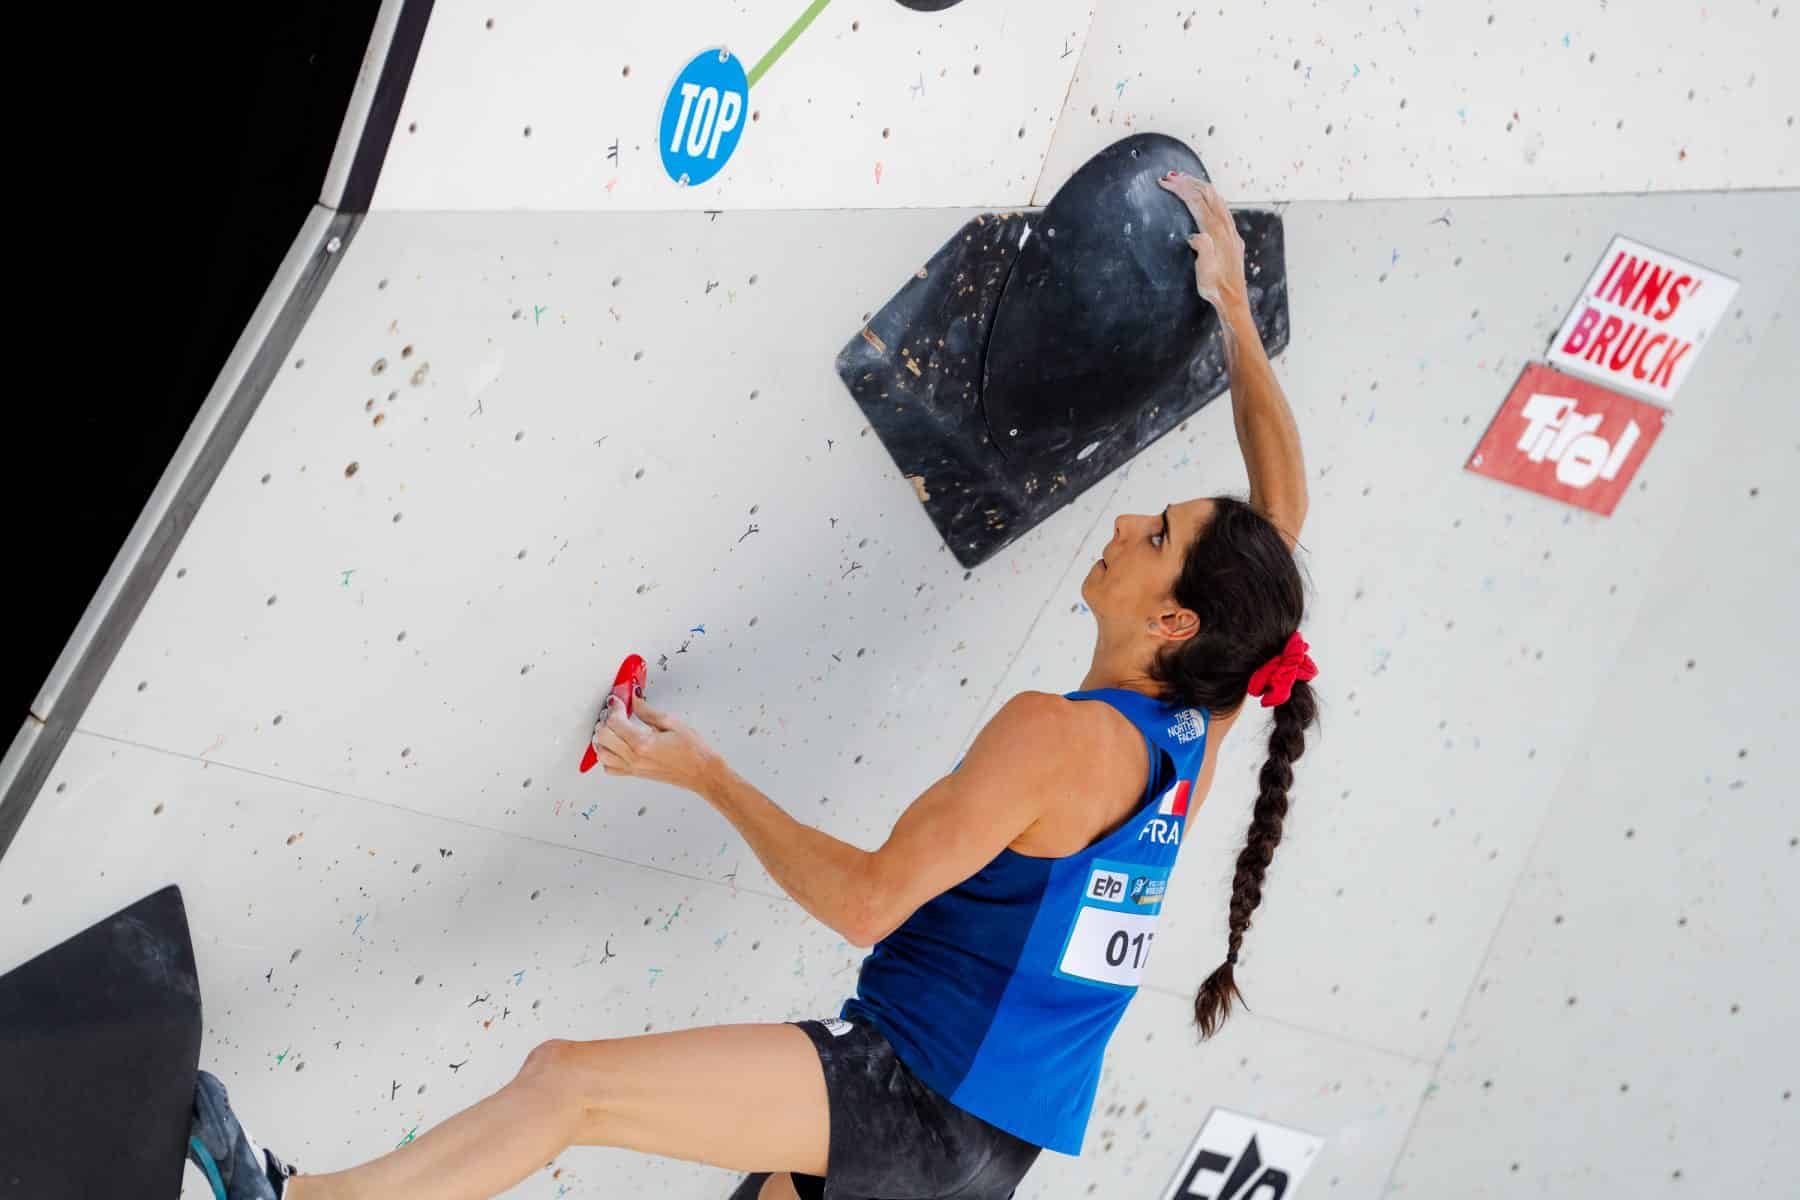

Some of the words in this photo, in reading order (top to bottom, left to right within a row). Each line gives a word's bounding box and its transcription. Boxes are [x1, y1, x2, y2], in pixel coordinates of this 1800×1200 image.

[670, 82, 742, 160] TOP
[1562, 306, 1692, 388] BRUCK
[1516, 393, 1641, 489] Tirol
[1168, 720, 1194, 737] NORTH
[1173, 710, 1192, 723] THE
[1178, 728, 1197, 745] FACE
[1138, 818, 1179, 845] FRA
